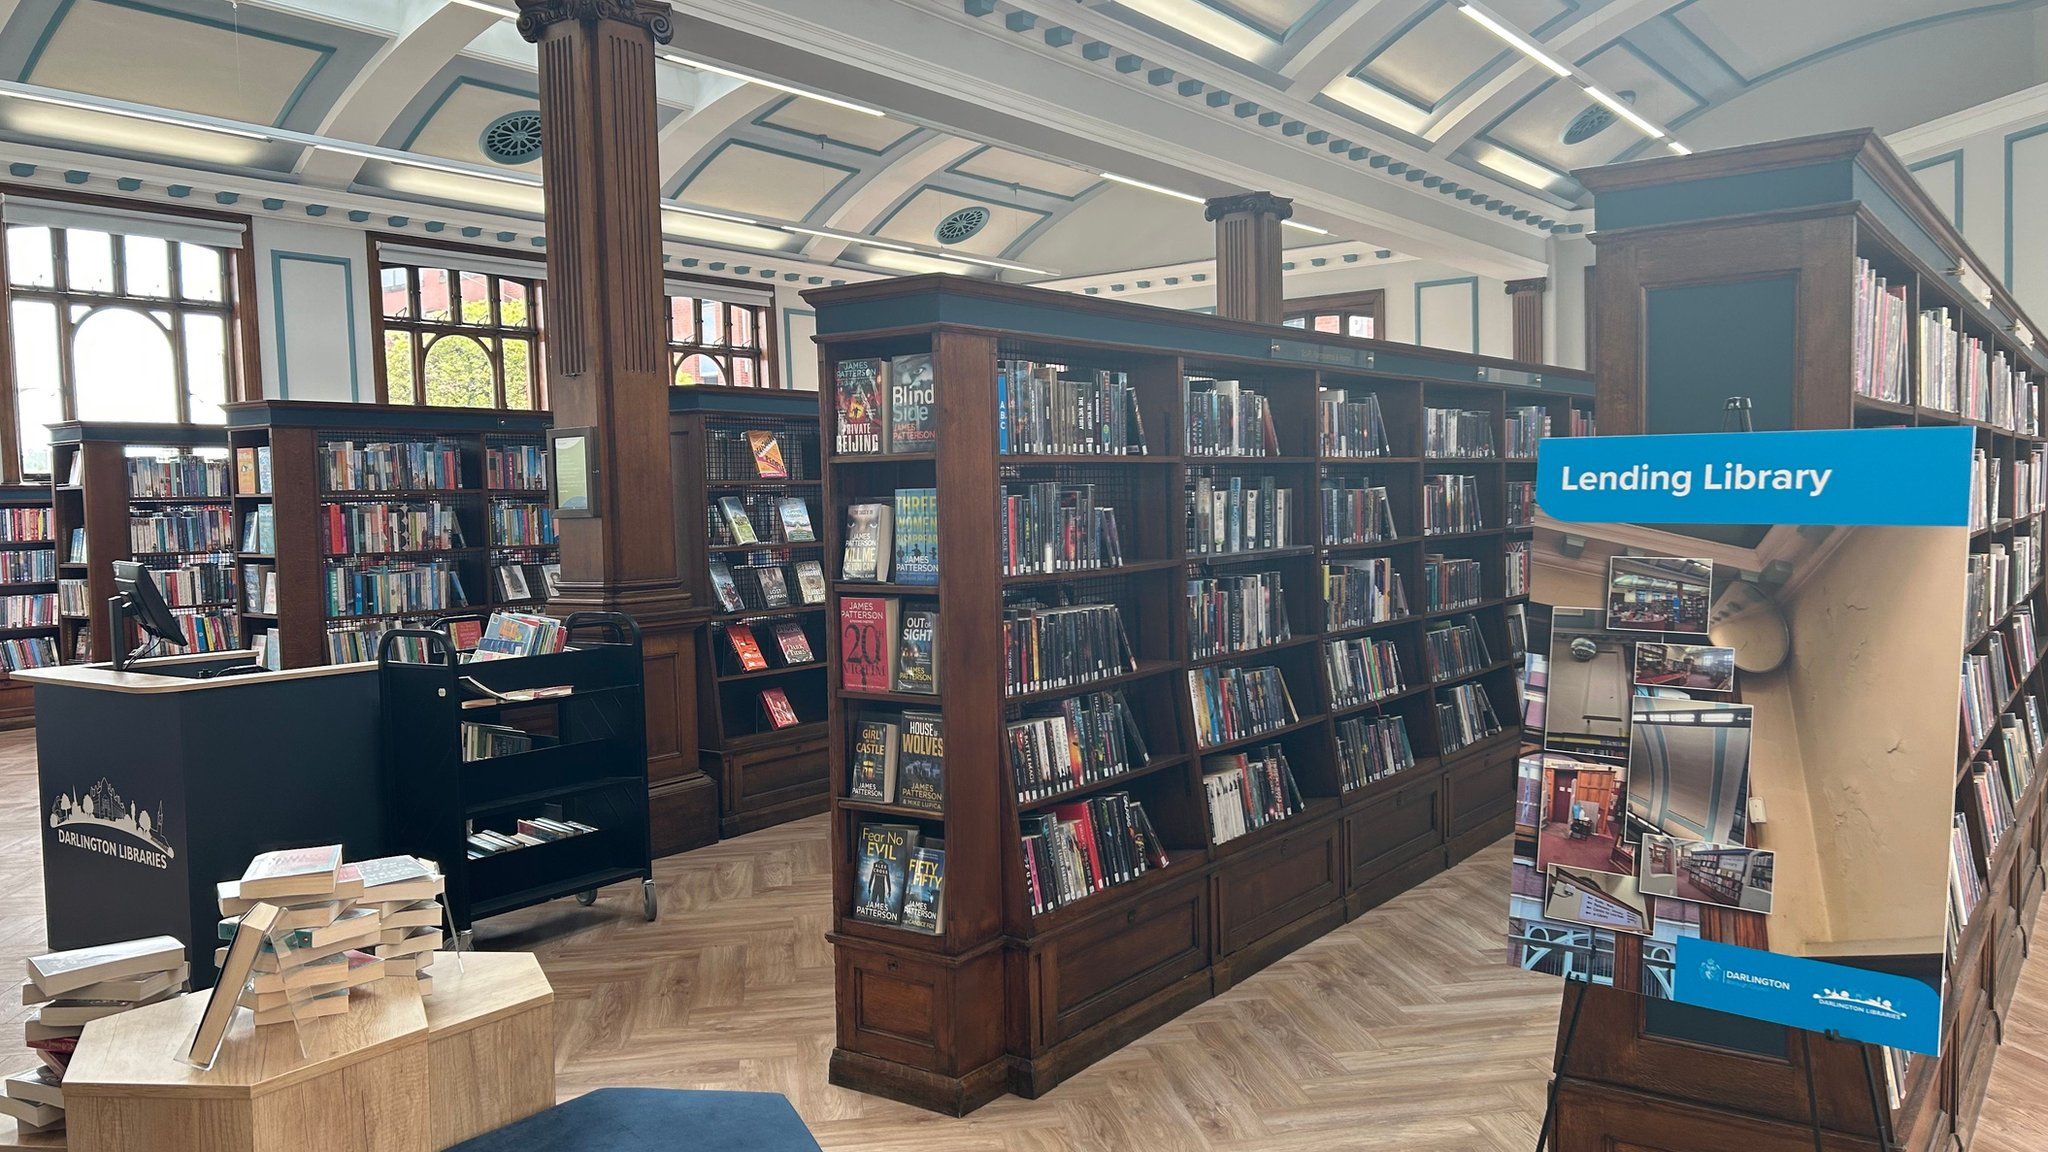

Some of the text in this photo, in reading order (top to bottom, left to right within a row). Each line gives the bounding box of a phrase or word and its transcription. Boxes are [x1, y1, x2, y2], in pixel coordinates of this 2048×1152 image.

[845, 361, 868, 370] JAMES
[837, 368, 876, 377] PATTERSON
[892, 384, 935, 405] Blind
[892, 405, 929, 422] Side
[842, 423, 871, 434] PRIVATE
[894, 423, 916, 431] JAMES
[893, 431, 936, 440] PATTERSON
[836, 434, 879, 453] BEIJING
[1561, 462, 1832, 498] Lending Library
[905, 555, 929, 563] JAMES
[896, 563, 939, 572] PATTERSON
[849, 602, 873, 611] JAMES
[841, 611, 884, 620] PATTERSON
[907, 617, 925, 628] OUT
[903, 629, 932, 642] SIGHT
[900, 672, 932, 681] PATTERSON
[905, 667, 925, 675] JAMES
[863, 729, 880, 740] GIRL
[910, 721, 934, 737] HOUSE
[855, 742, 885, 755] CASTLE
[902, 734, 944, 757] WOLVES
[852, 787, 883, 798] PATTERSON
[911, 783, 934, 792] JAMES
[903, 788, 942, 800] PATTERSON
[862, 827, 904, 846] Fear No
[58, 829, 167, 870] DARLINGTON LIBRARIES
[867, 842, 897, 860] EVIL
[909, 858, 939, 875] FIFTY
[913, 872, 943, 889] FIFTY
[866, 901, 889, 911] JAMES
[907, 901, 927, 910] JAMES
[856, 906, 898, 921] PATTERSON
[904, 906, 937, 919] PATTERSON
[1726, 970, 1790, 990] DARLINGTON
